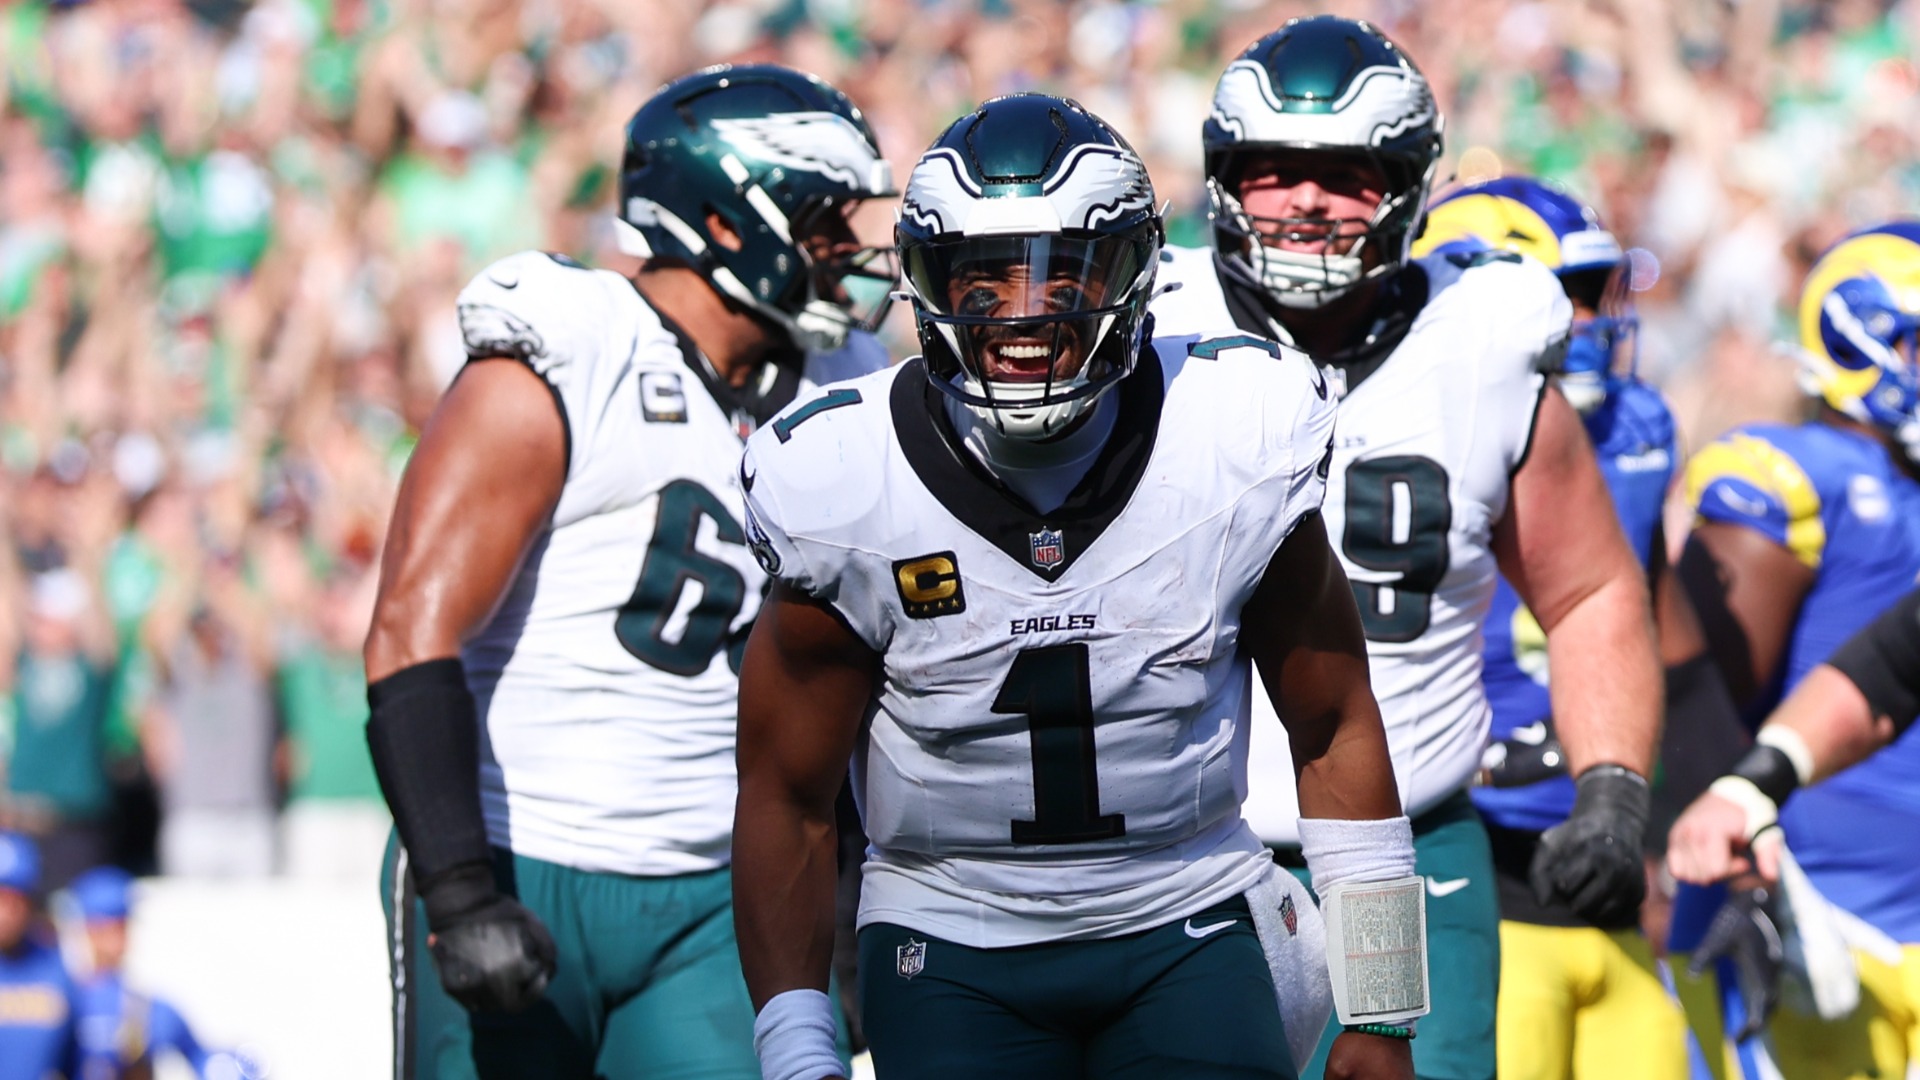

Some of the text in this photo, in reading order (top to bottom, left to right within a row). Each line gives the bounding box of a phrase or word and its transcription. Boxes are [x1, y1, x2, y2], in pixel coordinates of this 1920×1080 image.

[1187, 334, 1281, 361] 1
[641, 372, 685, 414] C
[773, 387, 862, 444] 1
[1036, 546, 1062, 563] NFL
[614, 478, 771, 678] 6
[898, 556, 959, 603] C
[1010, 614, 1097, 636] EAGLES
[990, 642, 1126, 846] 1
